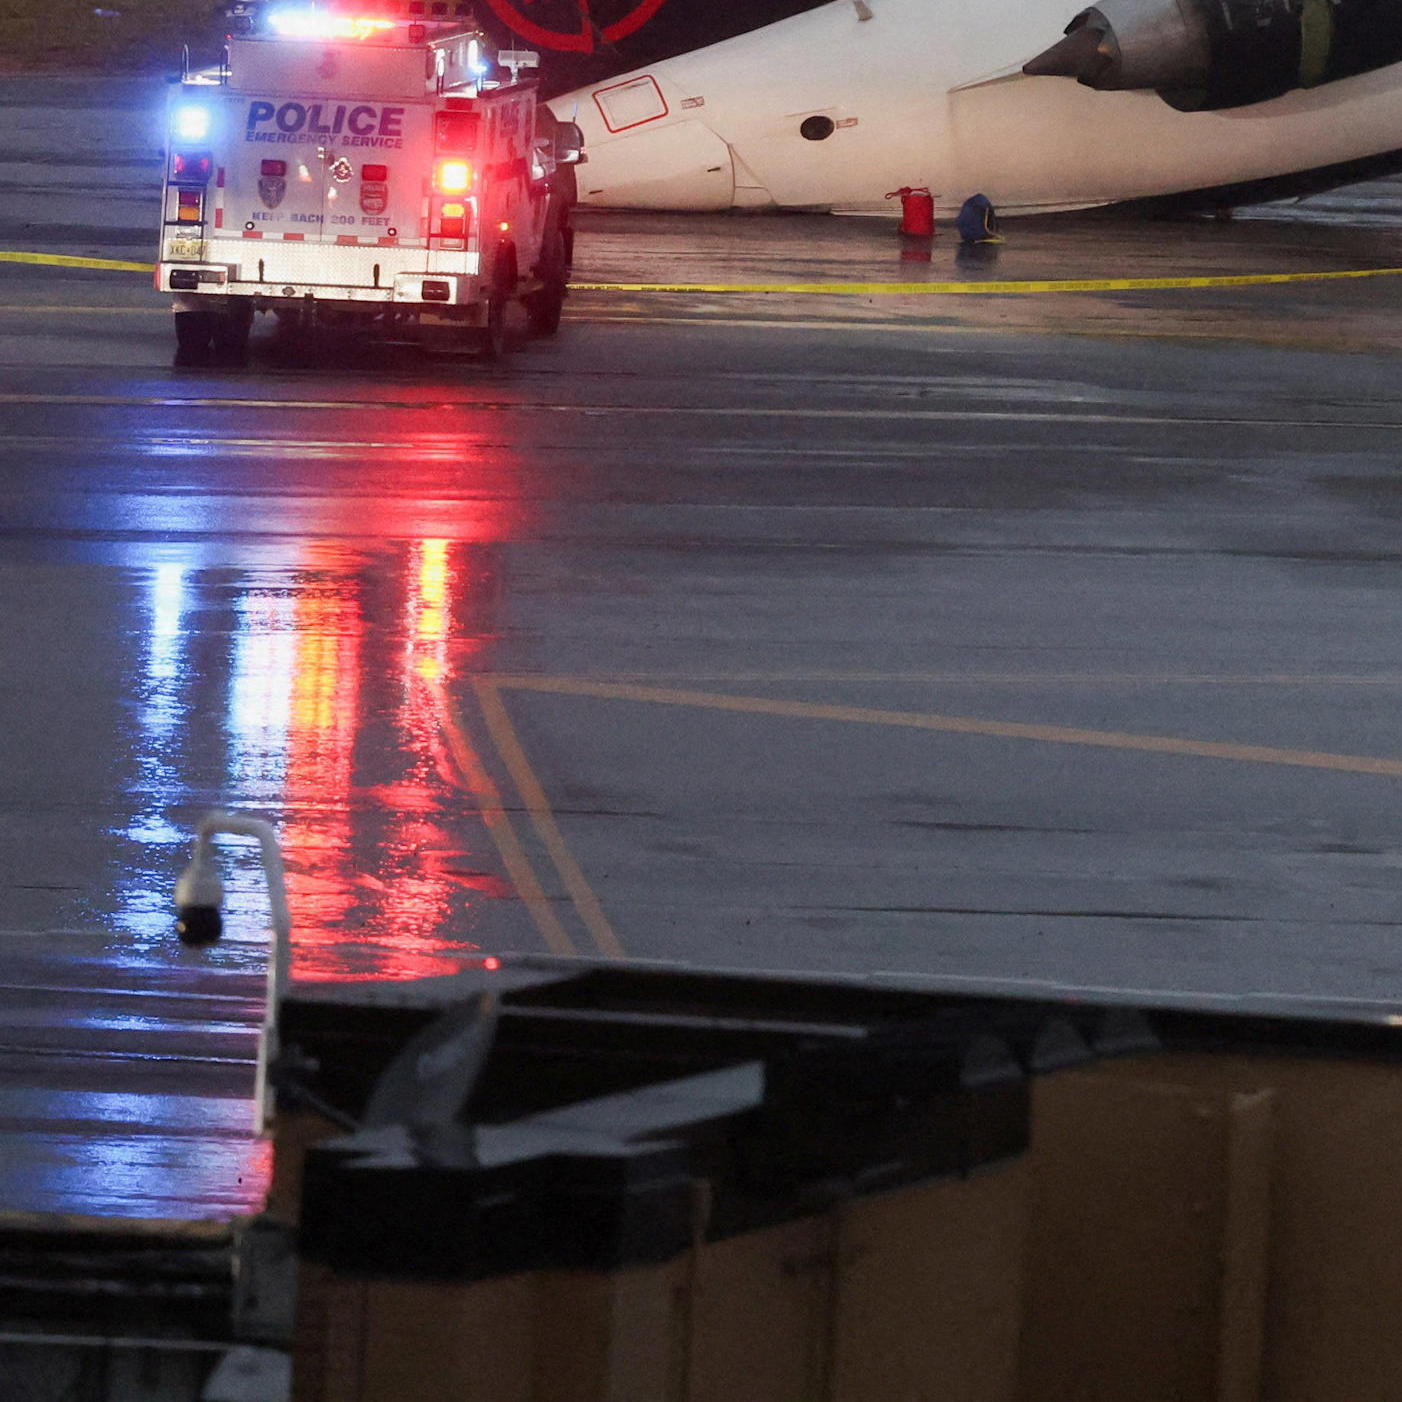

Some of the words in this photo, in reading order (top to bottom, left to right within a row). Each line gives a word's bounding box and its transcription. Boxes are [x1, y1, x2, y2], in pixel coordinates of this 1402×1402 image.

[246, 100, 405, 137] POLICE
[246, 131, 338, 145] EMERGENCY
[341, 135, 404, 149] SERVICE
[331, 214, 355, 225] 200
[361, 216, 390, 226] FEET
